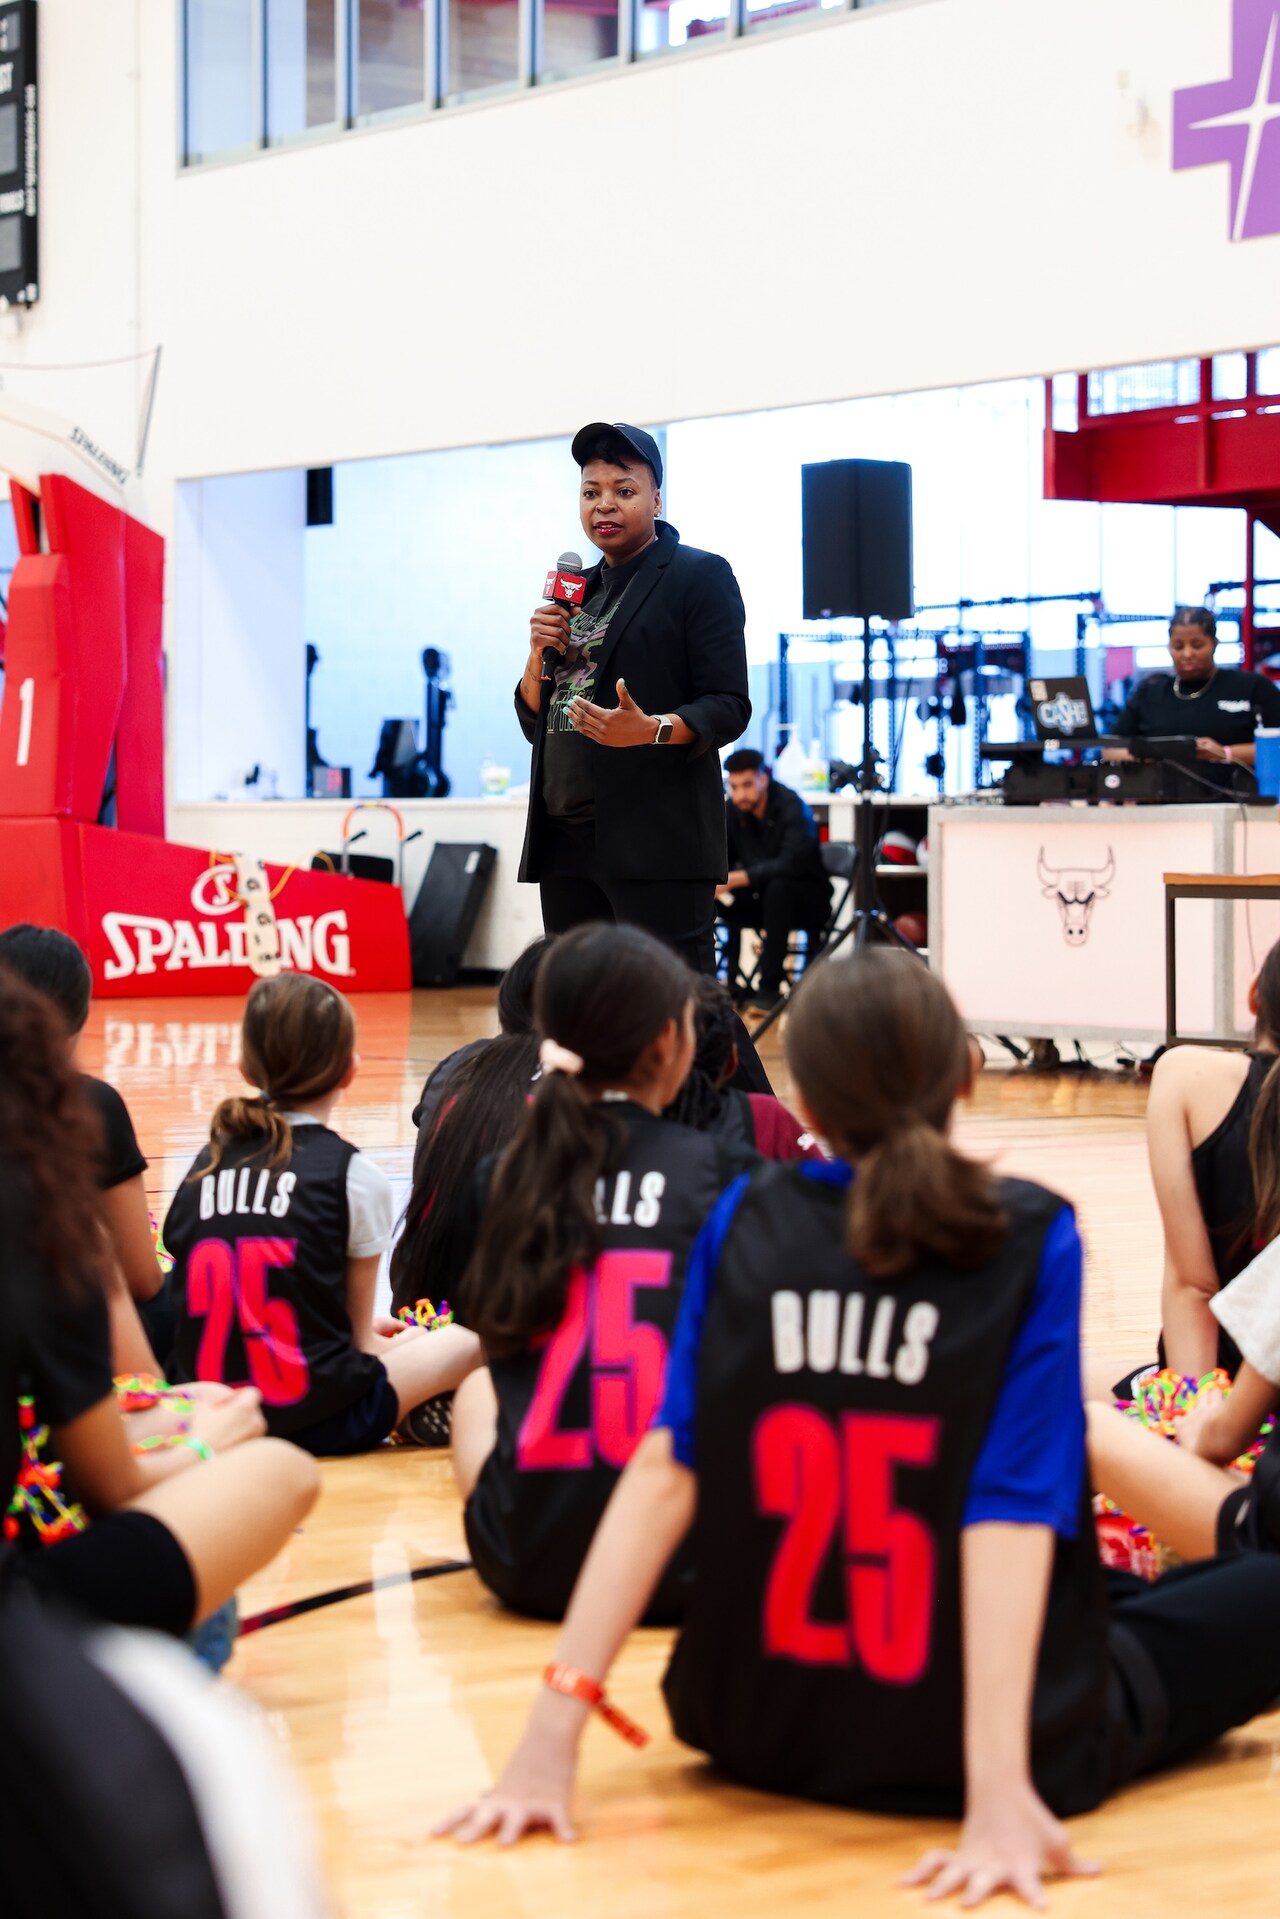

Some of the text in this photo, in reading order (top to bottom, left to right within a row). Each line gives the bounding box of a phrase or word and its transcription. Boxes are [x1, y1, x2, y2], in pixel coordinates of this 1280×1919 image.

[16, 677, 35, 766] 1
[101, 910, 351, 979] SPALDNG
[199, 1167, 298, 1220] BULLS
[594, 1170, 667, 1228] LLS
[186, 1237, 310, 1407] 25
[515, 1249, 673, 1470] 25
[771, 1289, 940, 1385] BULLS
[751, 1403, 941, 1686] 25
